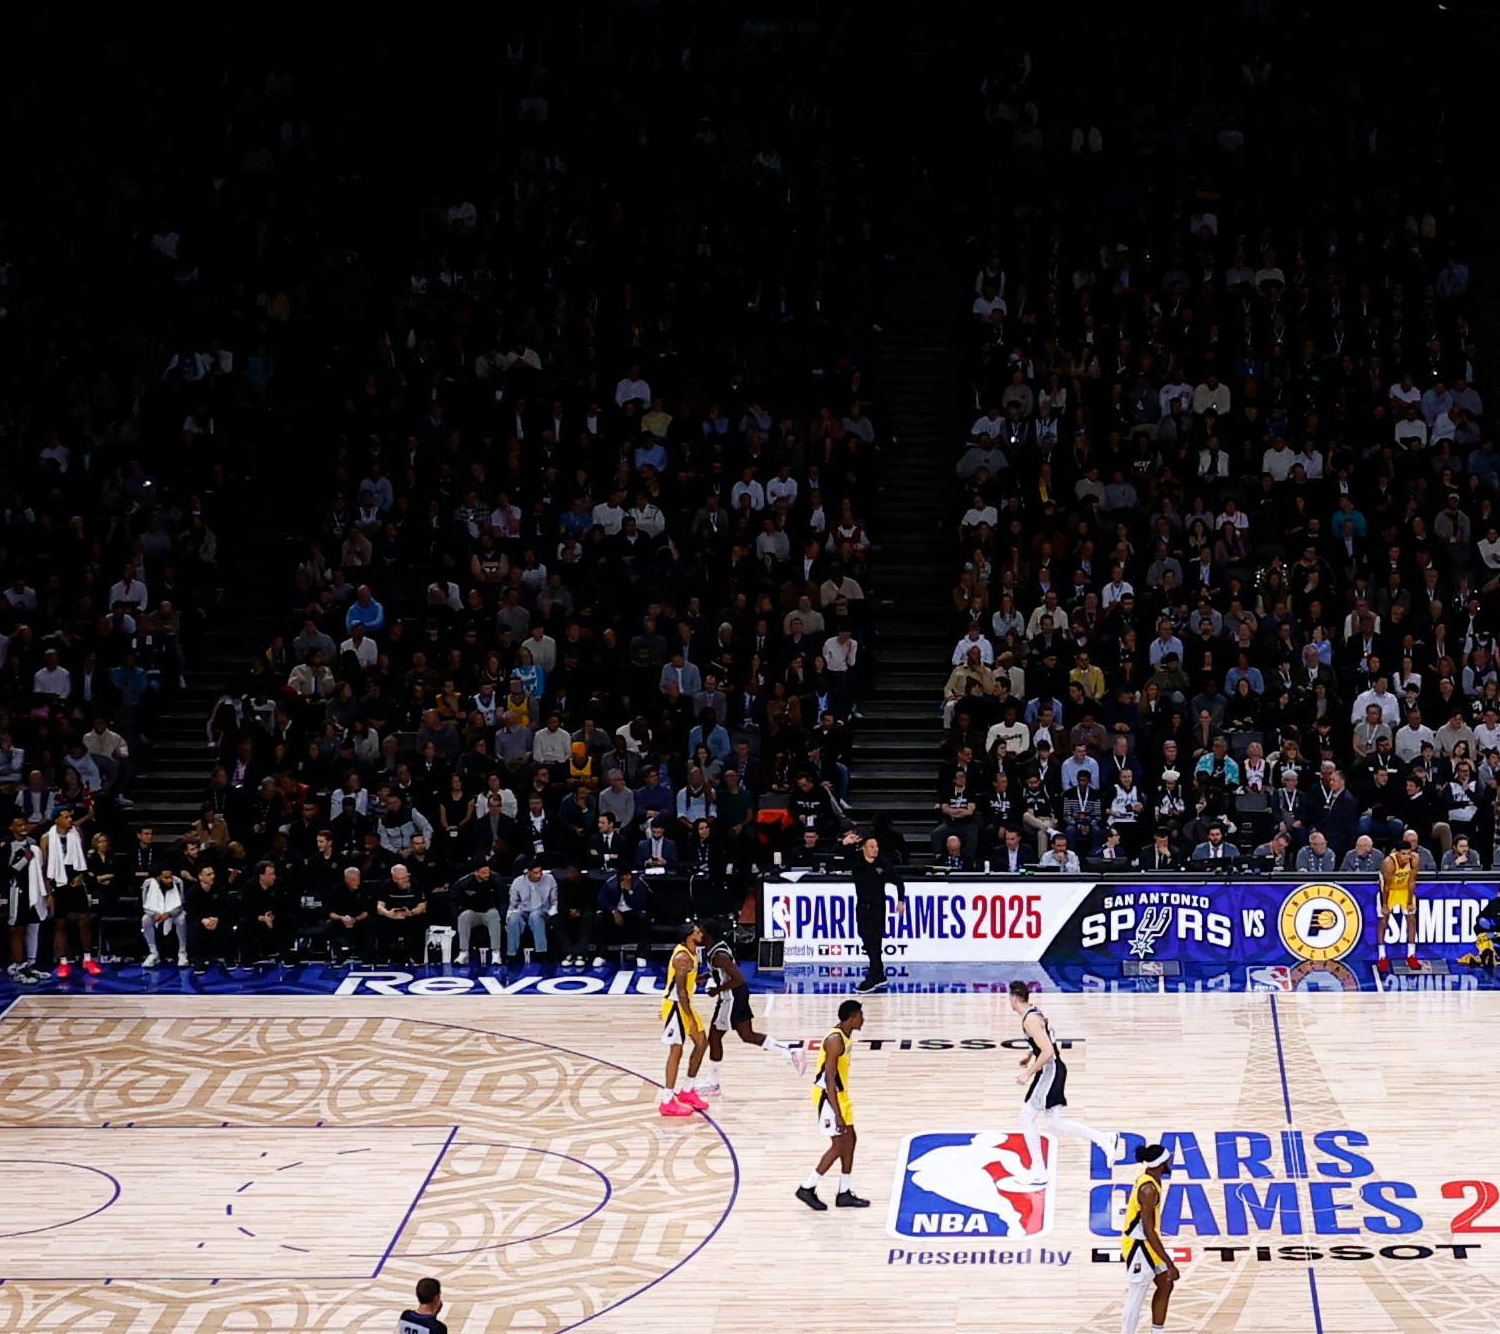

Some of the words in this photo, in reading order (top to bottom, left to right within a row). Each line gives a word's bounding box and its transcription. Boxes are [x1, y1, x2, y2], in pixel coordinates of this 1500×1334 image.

[1104, 894, 1134, 909] SAN
[1138, 892, 1210, 909] ANTONIO
[796, 895, 855, 939] PARI
[883, 895, 966, 939] GAMES
[971, 894, 1042, 939] 2025
[1242, 909, 1265, 938] VS
[1384, 898, 1490, 944] SAMED
[1081, 907, 1232, 960] SPURS
[334, 970, 713, 996] Revolu
[1090, 1130, 1374, 1180] PARIS
[1088, 1180, 1423, 1237] GAMES
[912, 1213, 989, 1234] NBA
[888, 1248, 1032, 1265] Presented
[1037, 1247, 1072, 1267] by
[1203, 1243, 1481, 1262] TISSOT
